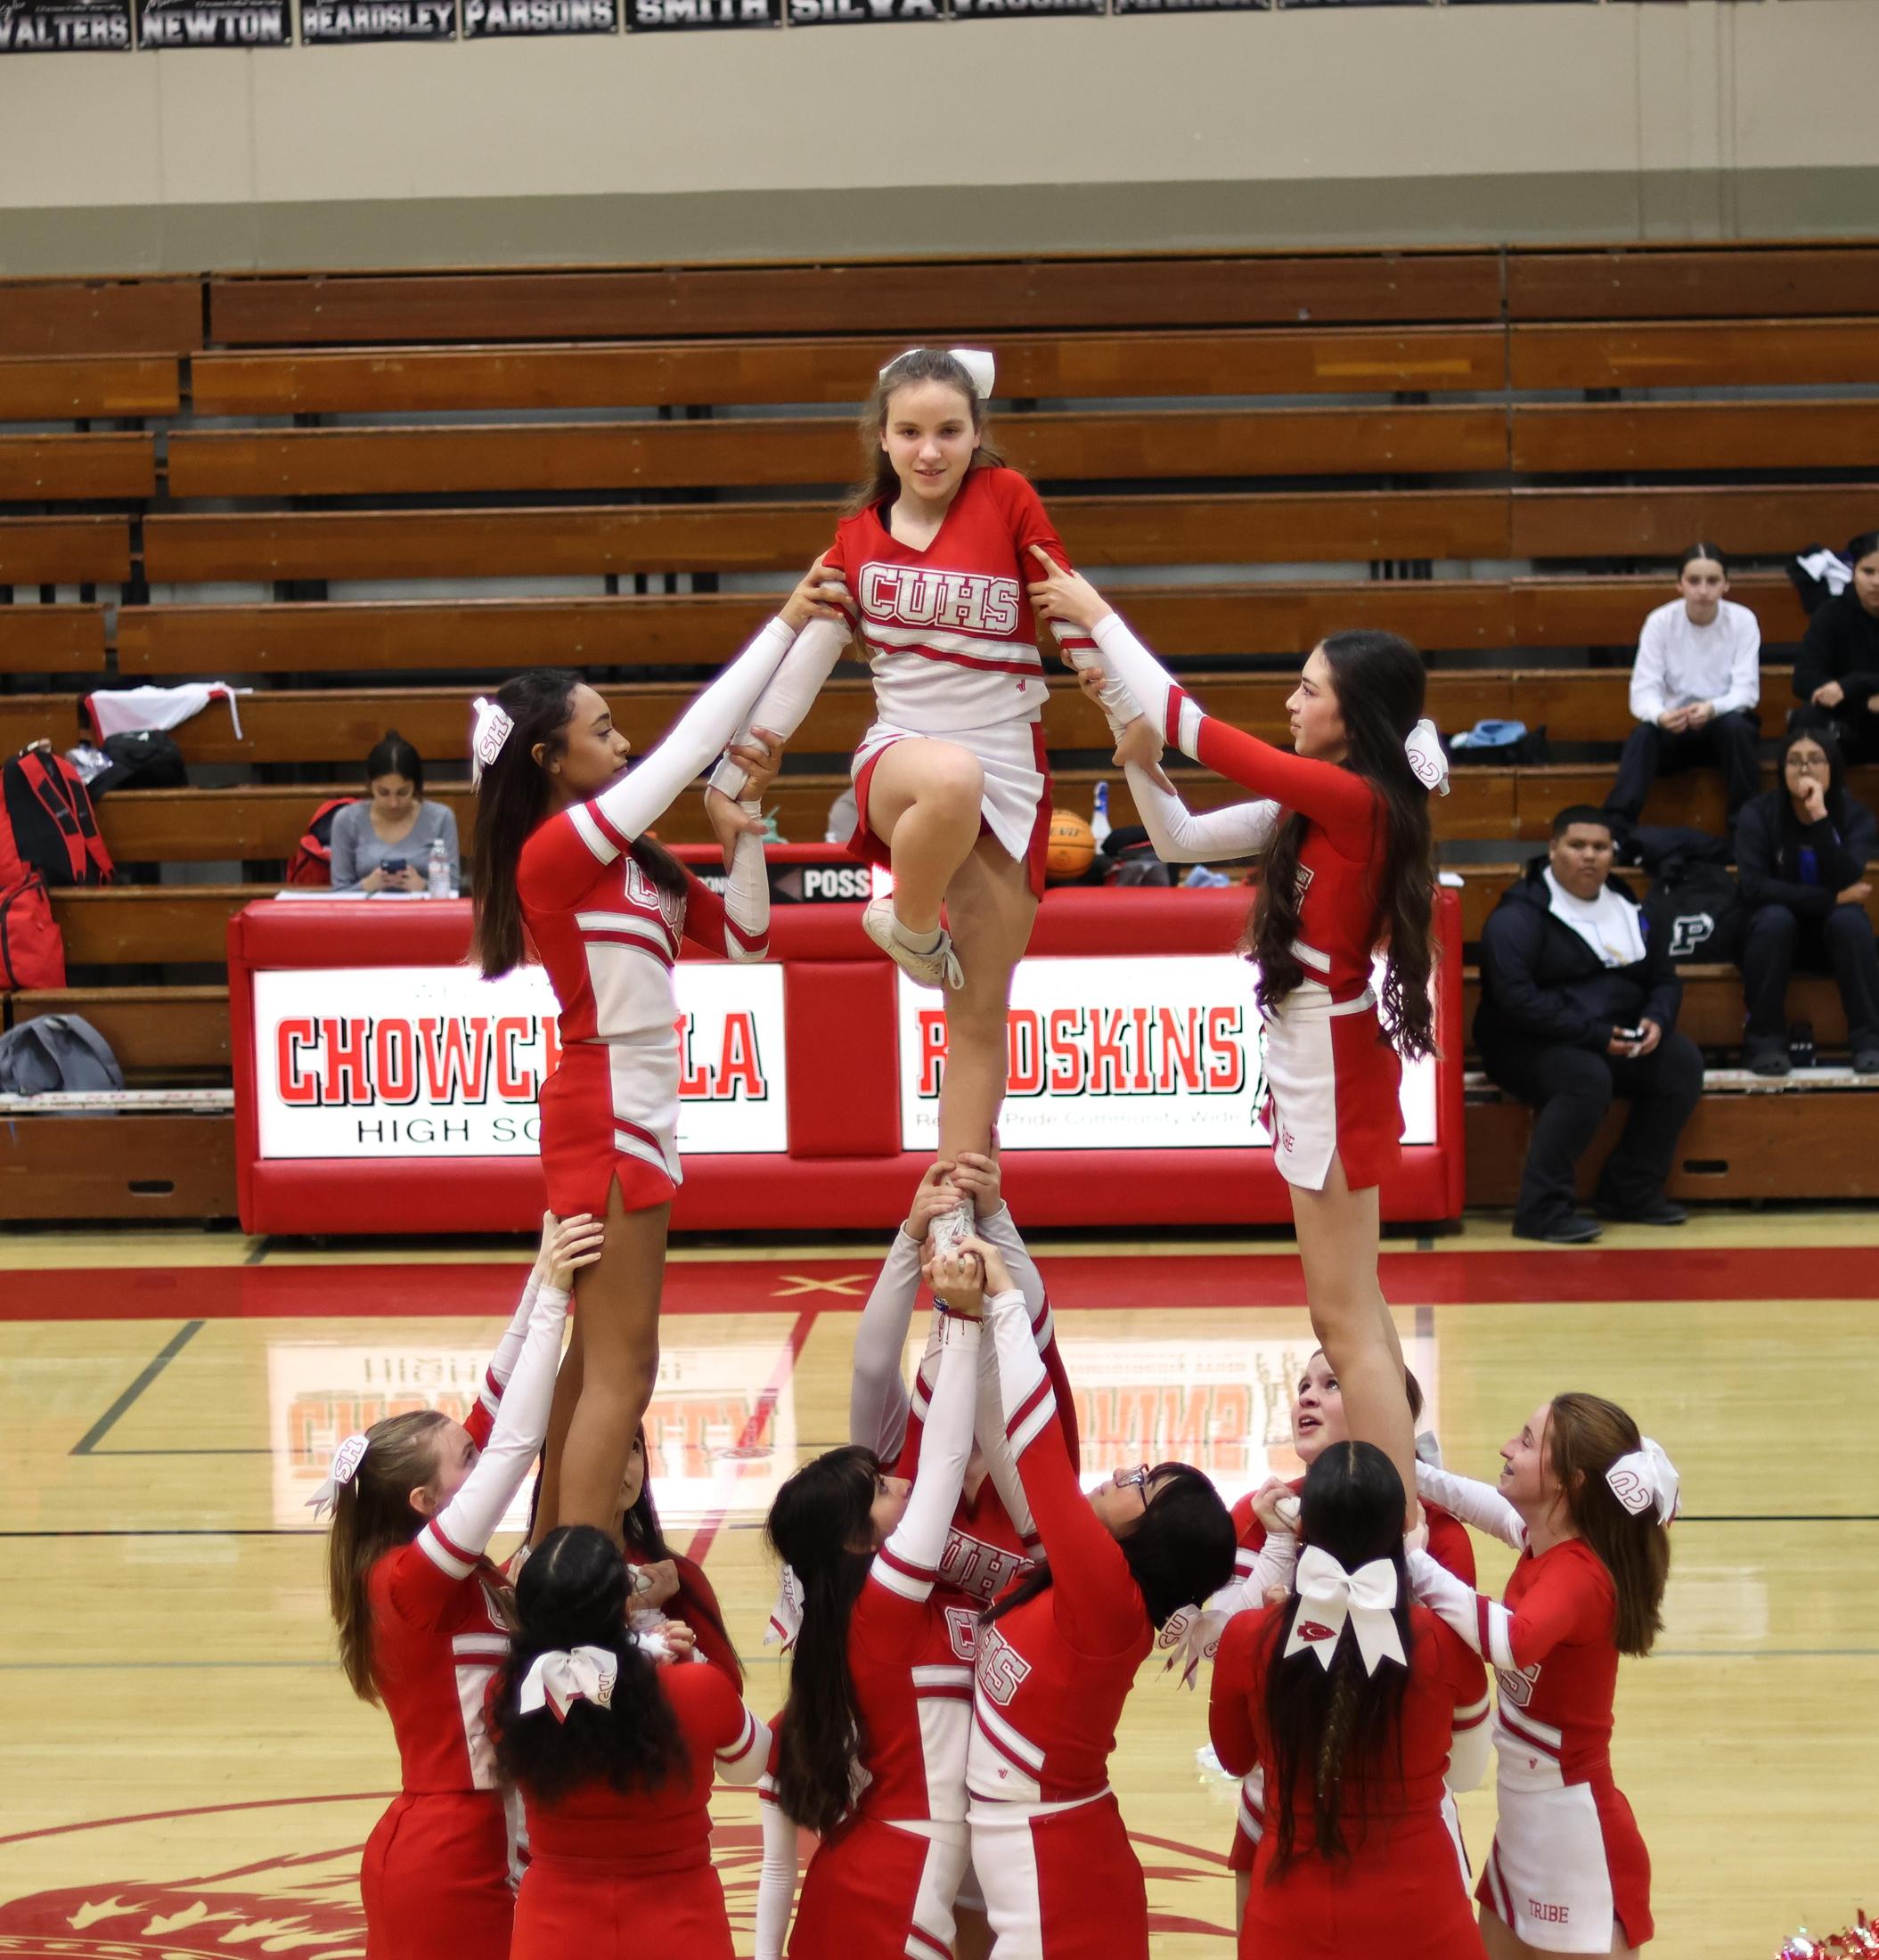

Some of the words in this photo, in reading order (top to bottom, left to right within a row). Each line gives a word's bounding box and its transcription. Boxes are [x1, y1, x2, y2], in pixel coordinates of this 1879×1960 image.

[141, 8, 283, 44] NEWTON
[301, 3, 455, 36] BEARDSLEY
[464, 0, 615, 31] PARSONS
[859, 561, 1020, 636] CUHS
[805, 870, 872, 898] POSS
[277, 1008, 768, 1107] CHOWCLA
[915, 1003, 1248, 1098] RDSKINS
[357, 1118, 470, 1144] HIGH
[1189, 1110, 1241, 1126] Wide
[1528, 1899, 1570, 1924] TRIBE
